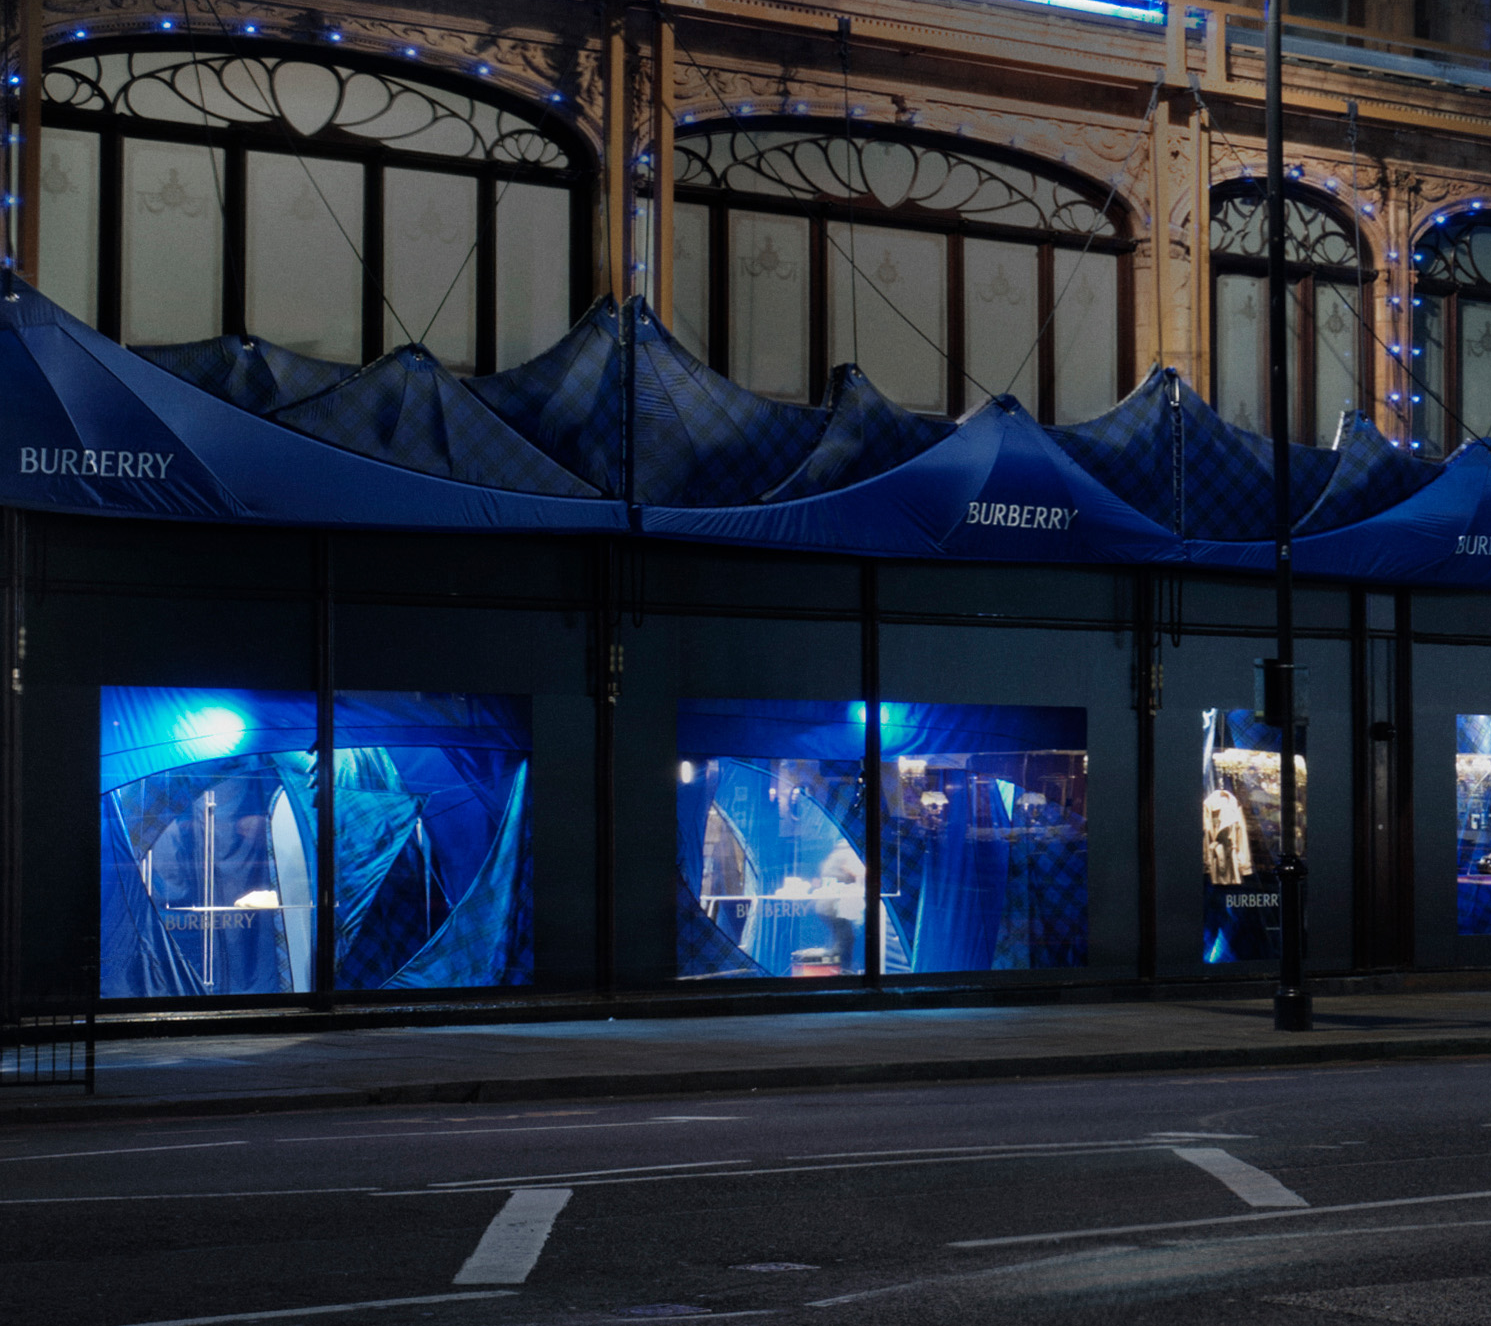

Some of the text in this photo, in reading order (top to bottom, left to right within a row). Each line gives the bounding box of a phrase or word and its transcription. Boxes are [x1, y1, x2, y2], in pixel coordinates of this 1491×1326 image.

[21, 447, 174, 479] BURBERRY
[966, 502, 1078, 530] BURBERRY
[1226, 893, 1279, 908] BURBERR
[736, 902, 809, 919] BUBERRY
[165, 912, 256, 931] BURBERRY
